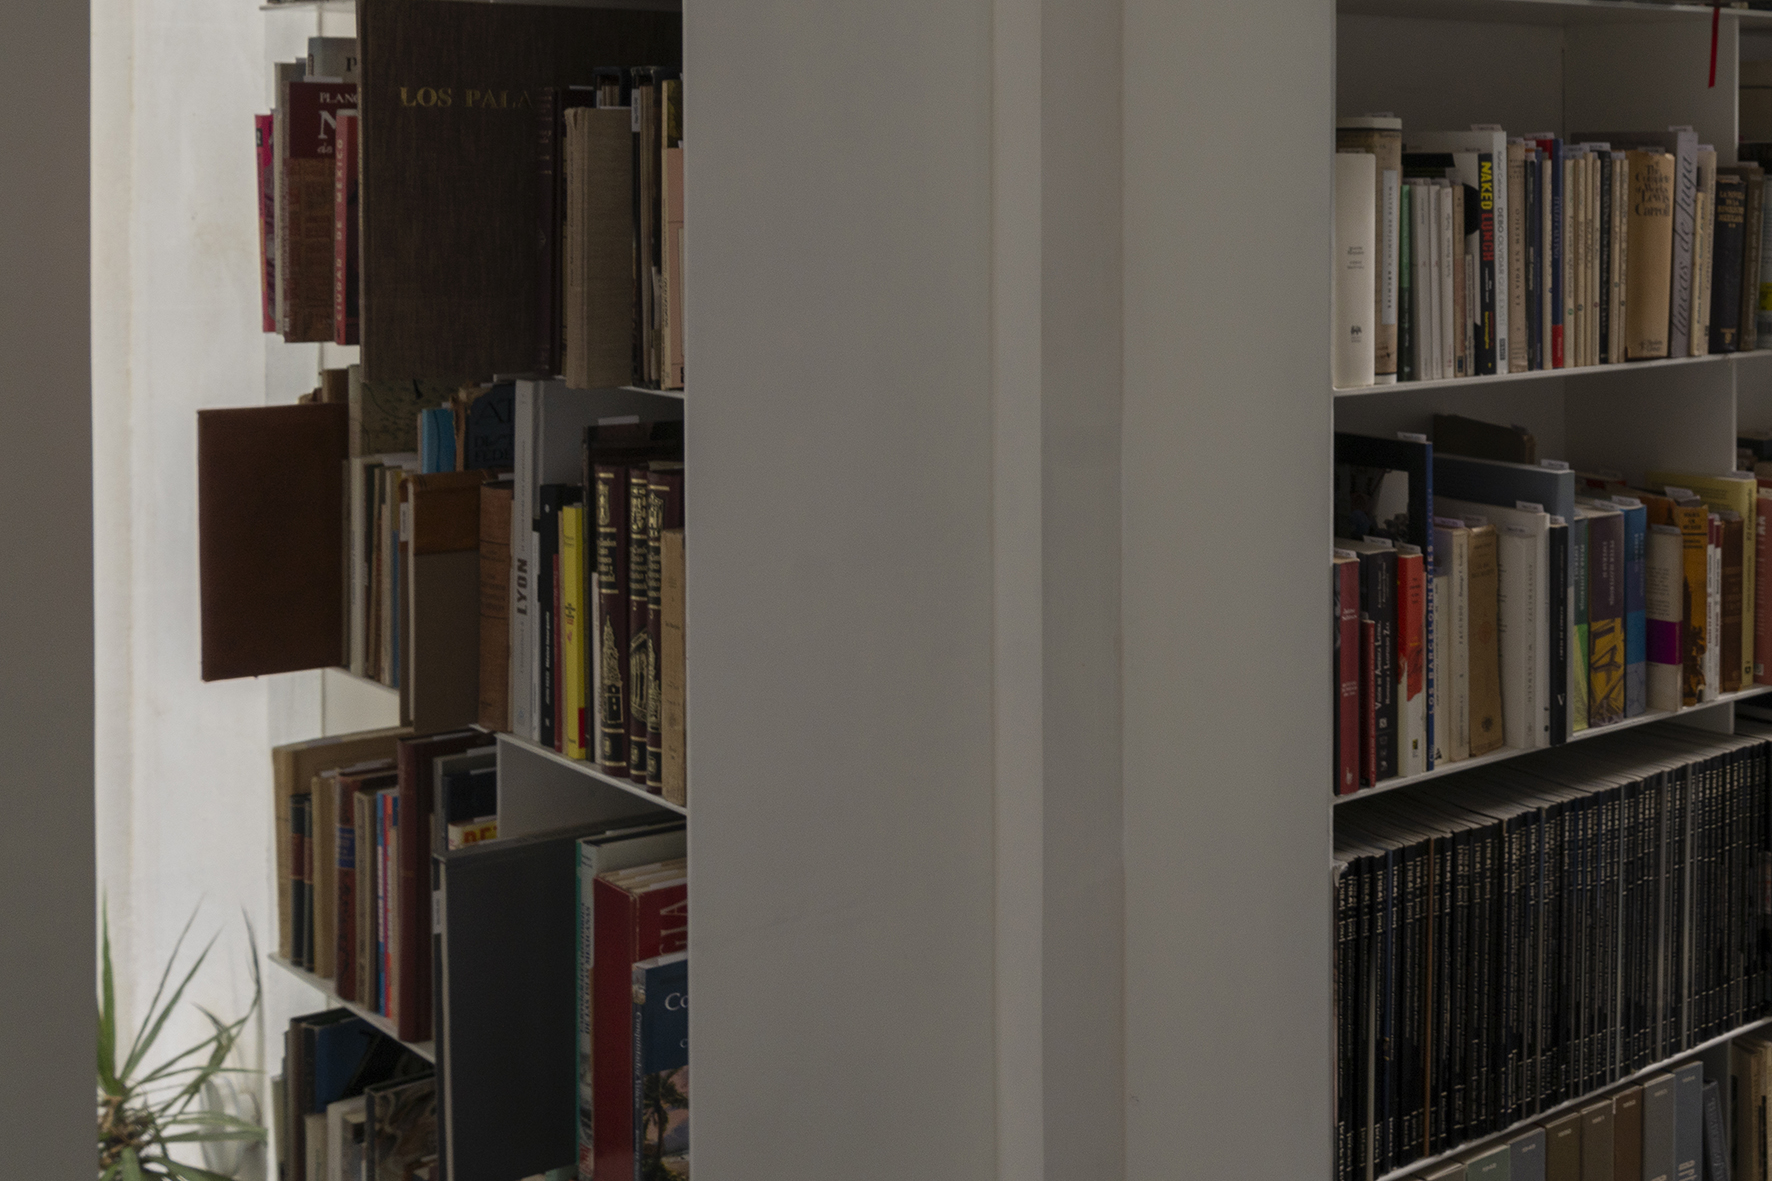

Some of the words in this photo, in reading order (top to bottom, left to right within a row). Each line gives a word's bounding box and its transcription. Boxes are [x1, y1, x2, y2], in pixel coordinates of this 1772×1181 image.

[399, 85, 453, 108] LOS
[1480, 161, 1493, 210] NAKED
[336, 220, 344, 241] DE
[1481, 212, 1494, 262] LUNCH
[1671, 221, 1689, 253] de
[336, 257, 344, 322] CIUDAD
[516, 557, 528, 617] LYON
